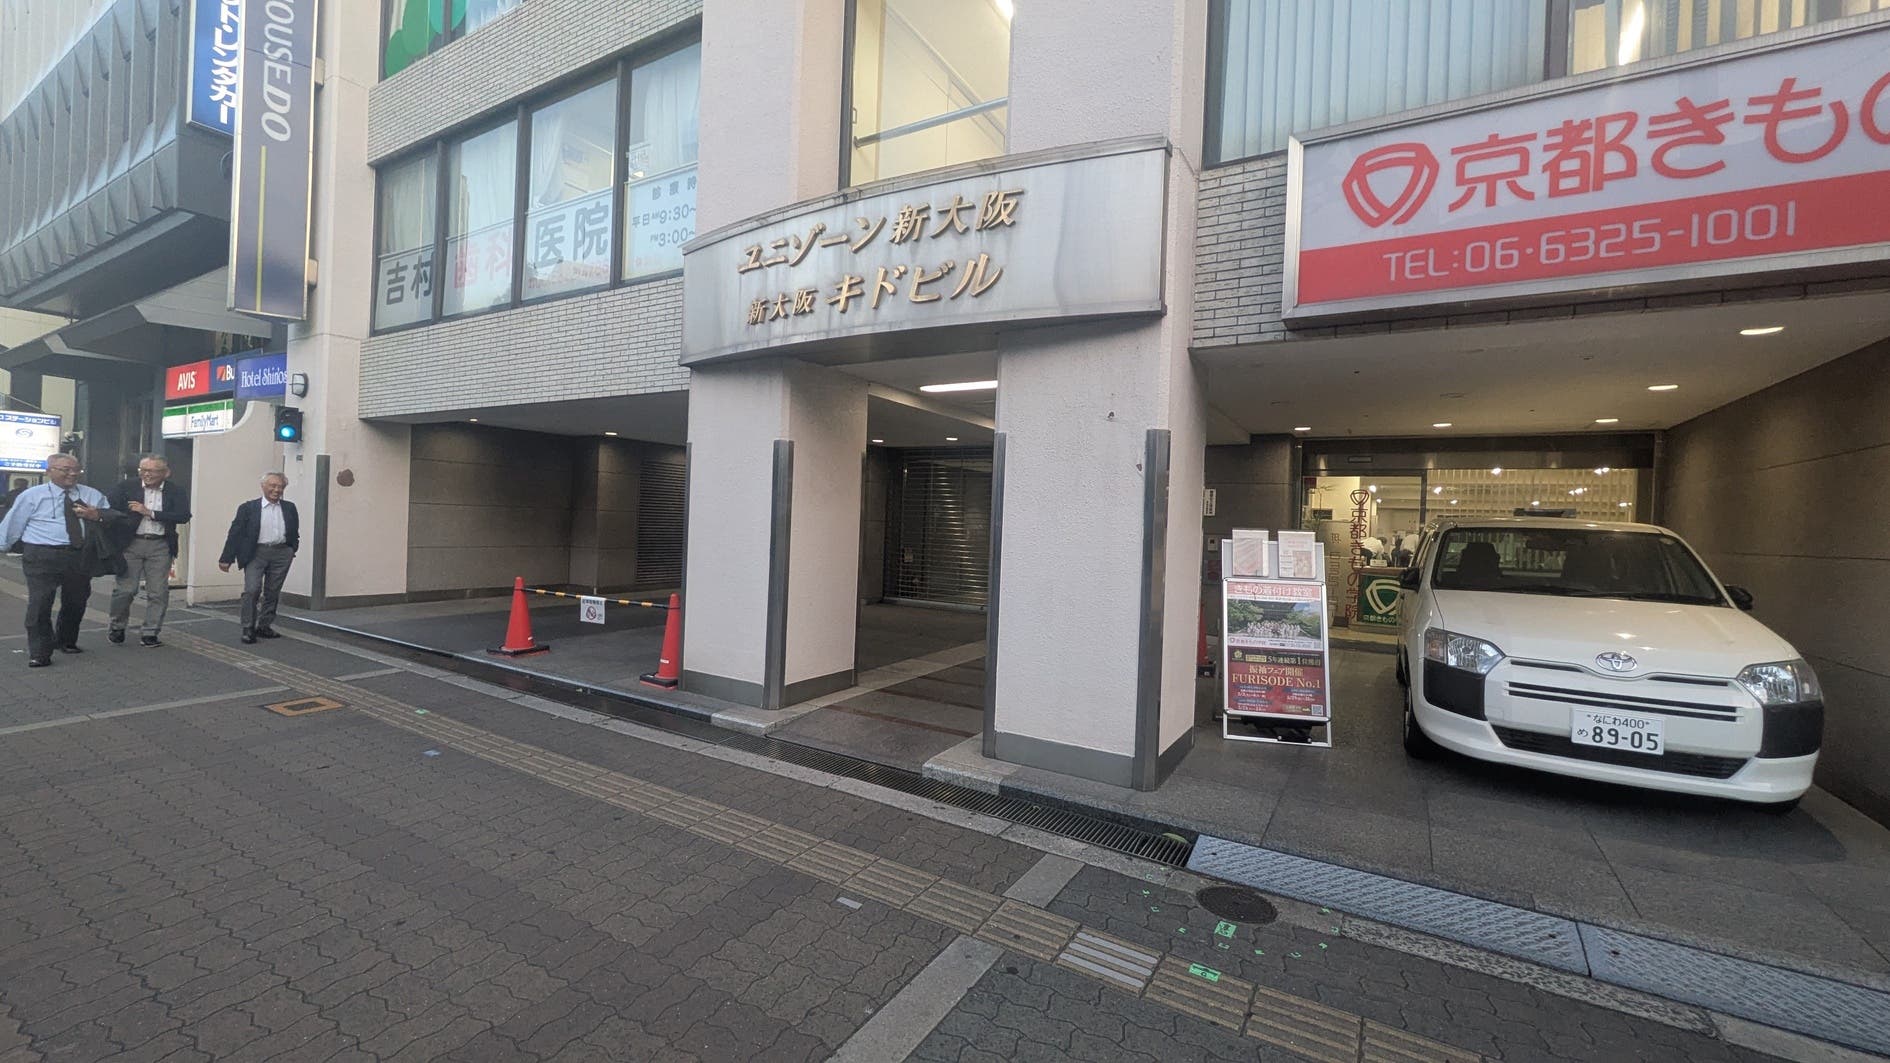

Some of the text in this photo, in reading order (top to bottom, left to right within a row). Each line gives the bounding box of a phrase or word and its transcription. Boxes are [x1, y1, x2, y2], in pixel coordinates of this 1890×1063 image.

[261, 0, 295, 142] OUSEDO
[738, 187, 1025, 274] ユニゾーン新大阪
[746, 253, 1005, 325] 新大阪 キドビル
[177, 370, 197, 391] AVIS
[241, 367, 262, 387] Hotel
[191, 414, 218, 430] FamilyMart
[1232, 673, 1321, 689] FURISODE No.1
[1577, 726, 1659, 751] め 89-05
